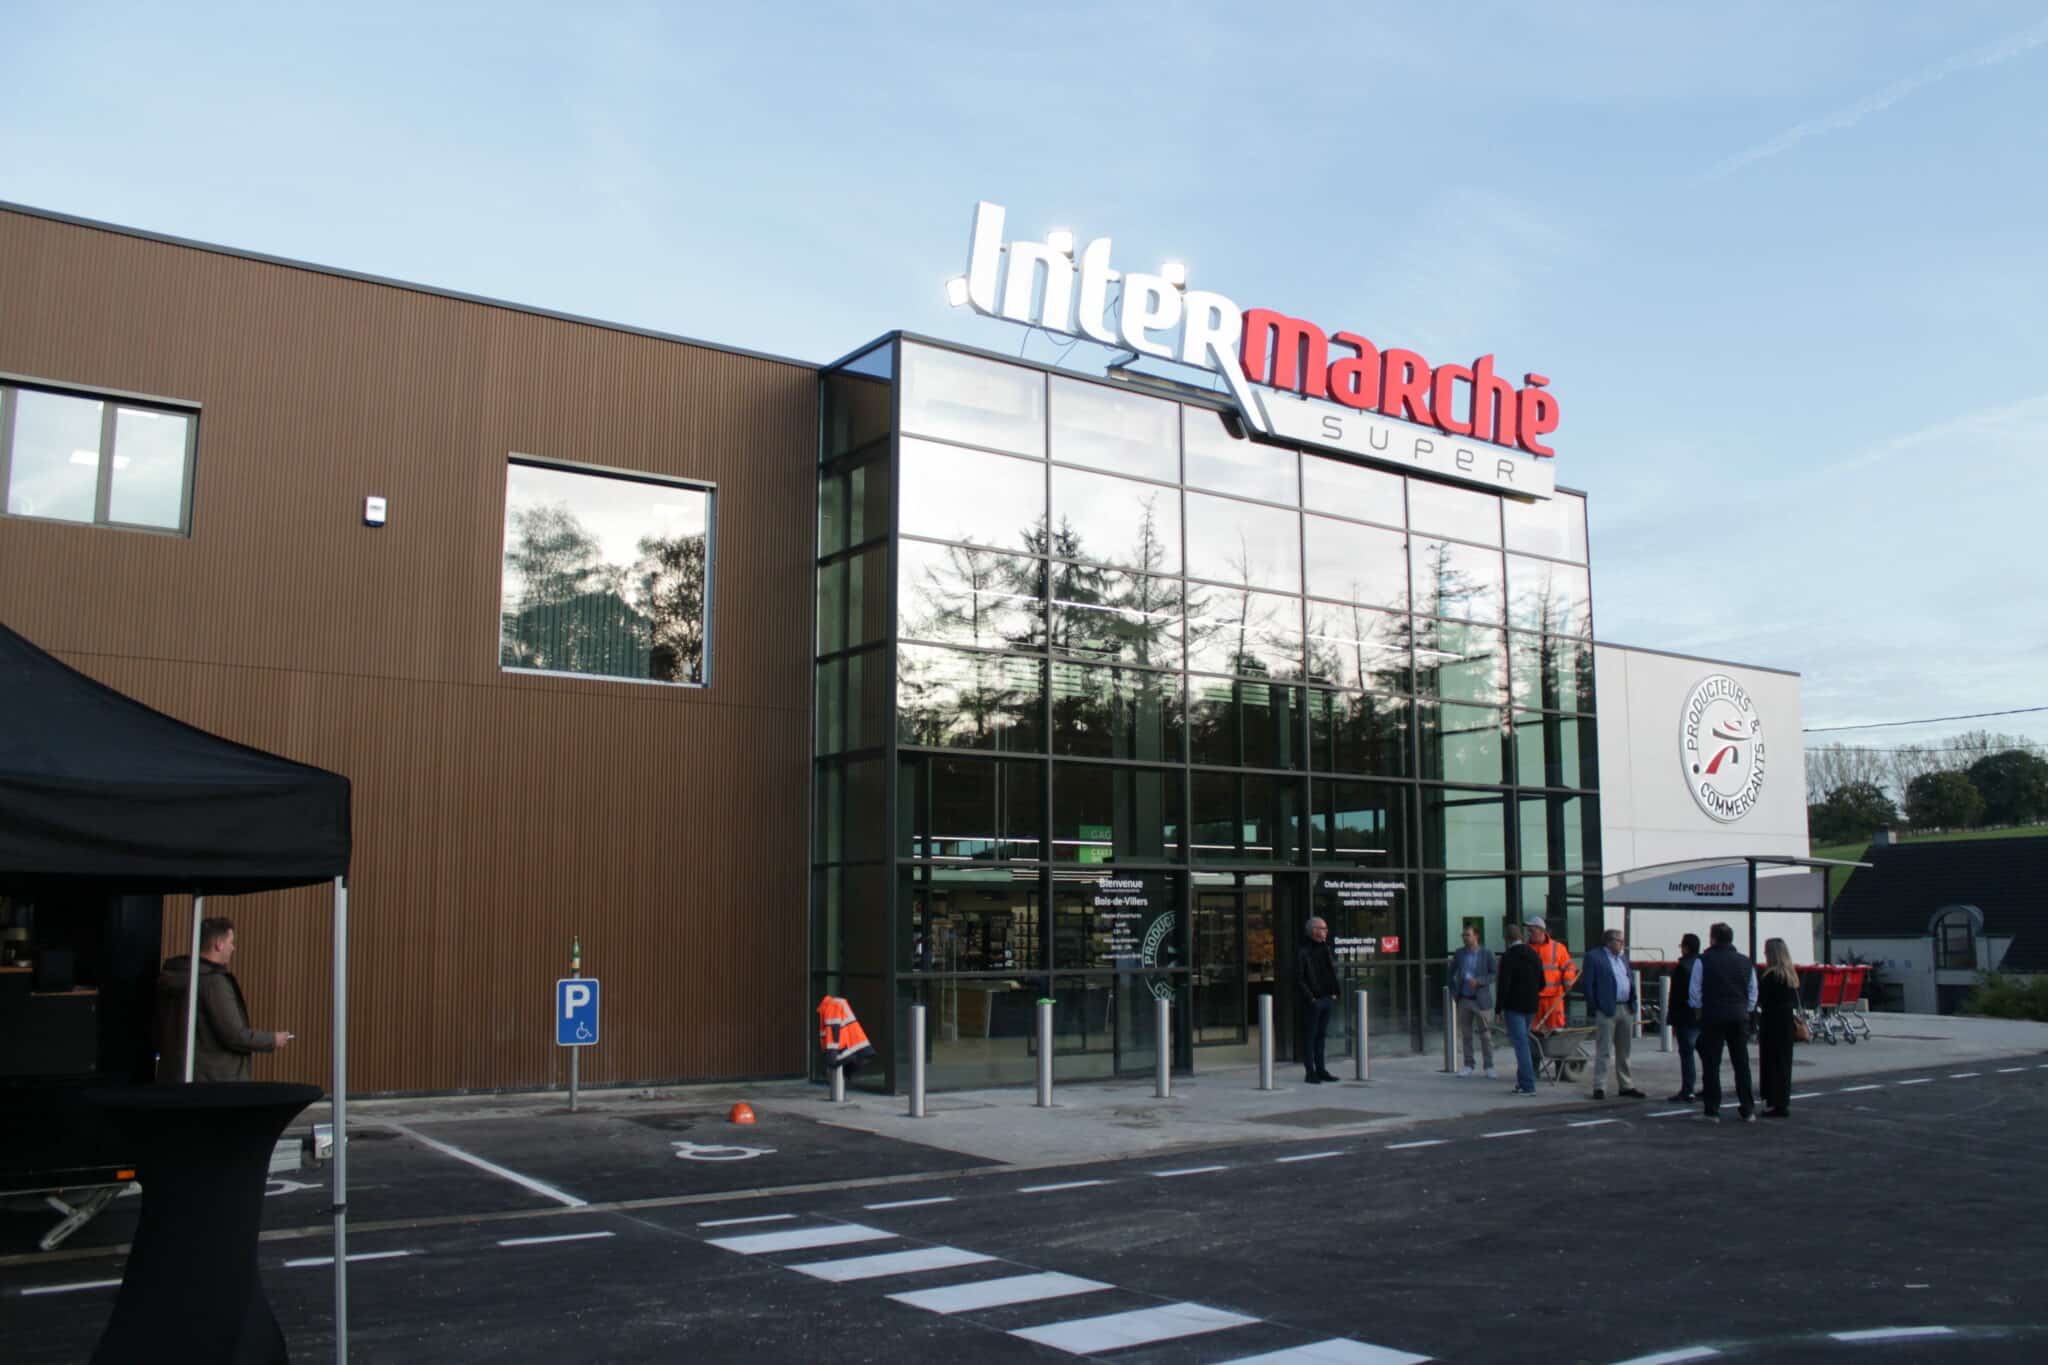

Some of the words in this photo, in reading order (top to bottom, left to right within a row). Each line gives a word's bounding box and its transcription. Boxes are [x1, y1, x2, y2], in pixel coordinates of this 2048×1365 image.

[1321, 414, 1516, 484] SUPER
[1687, 678, 1750, 751] PRODUCTEURS
[1094, 896, 1148, 906] Bois-de-Villers
[1099, 878, 1144, 889] Bienvenue
[565, 984, 591, 1019] P
